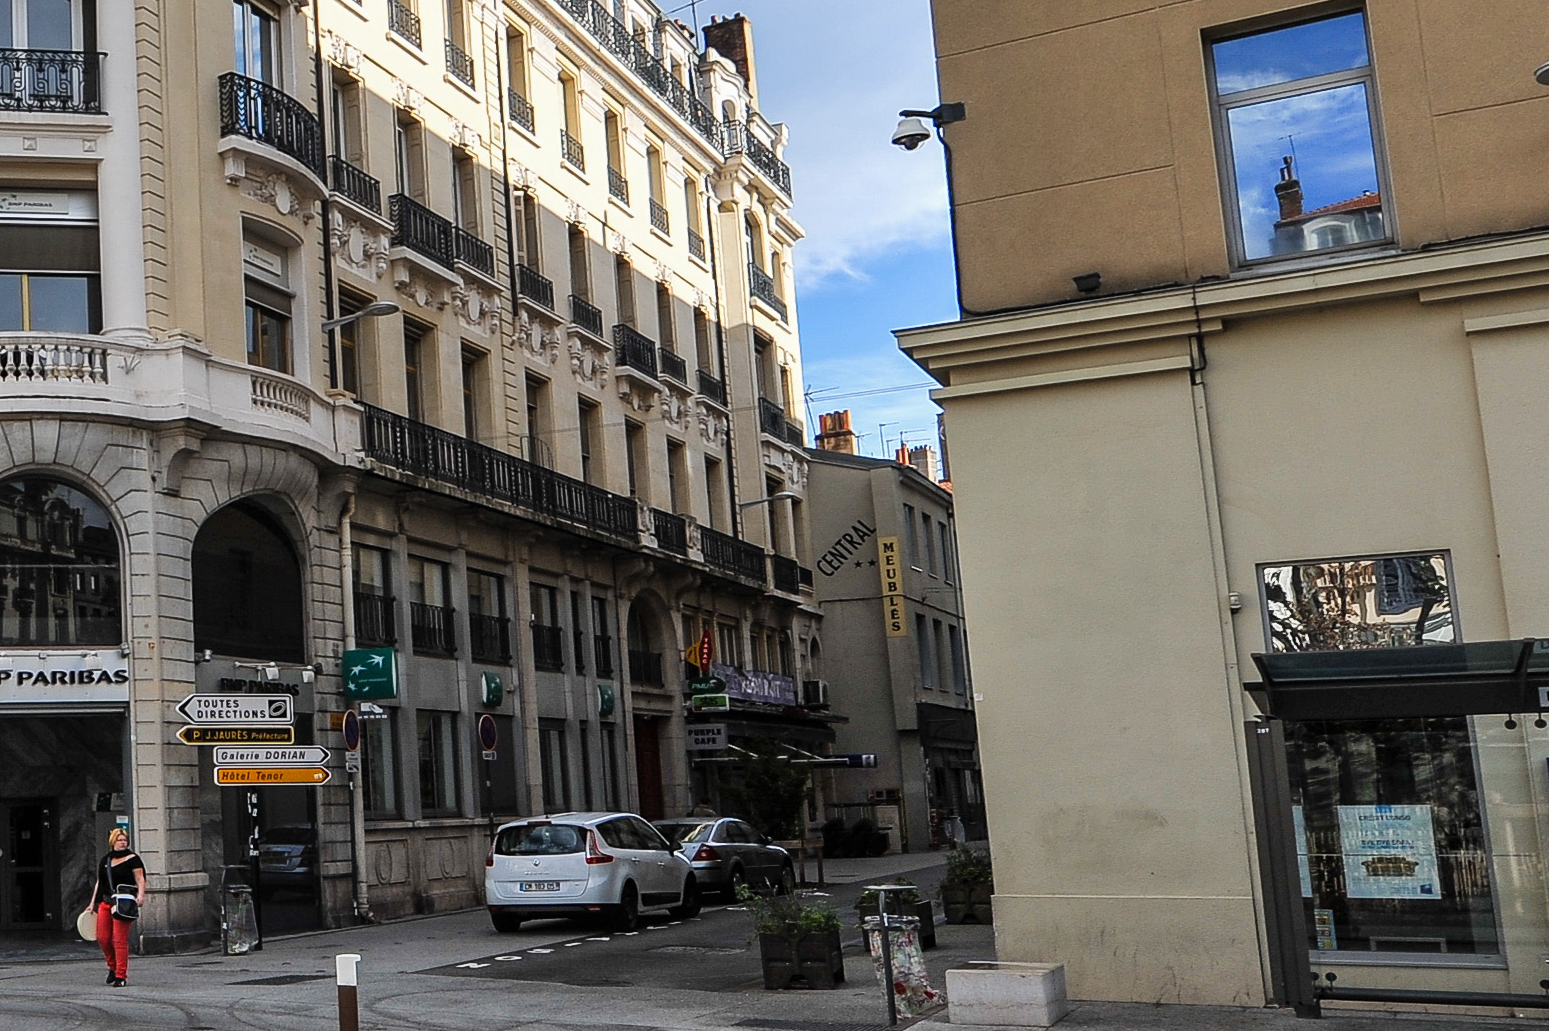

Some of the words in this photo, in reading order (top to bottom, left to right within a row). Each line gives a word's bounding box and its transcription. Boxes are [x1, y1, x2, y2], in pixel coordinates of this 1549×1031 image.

[816, 519, 877, 577] CENTRAL
[17, 670, 130, 686] PARIBAS
[220, 678, 247, 691] BNP
[248, 680, 300, 696] PARIBAS
[197, 699, 240, 708] TOUTES
[197, 710, 267, 719] DIRECTIONS
[251, 731, 288, 739] Préfecture
[688, 729, 722, 737] PURPLE
[221, 751, 260, 760] Galerie
[265, 750, 306, 760] DORIAN
[221, 771, 250, 781] Hôtel
[256, 771, 284, 781] Tenor
